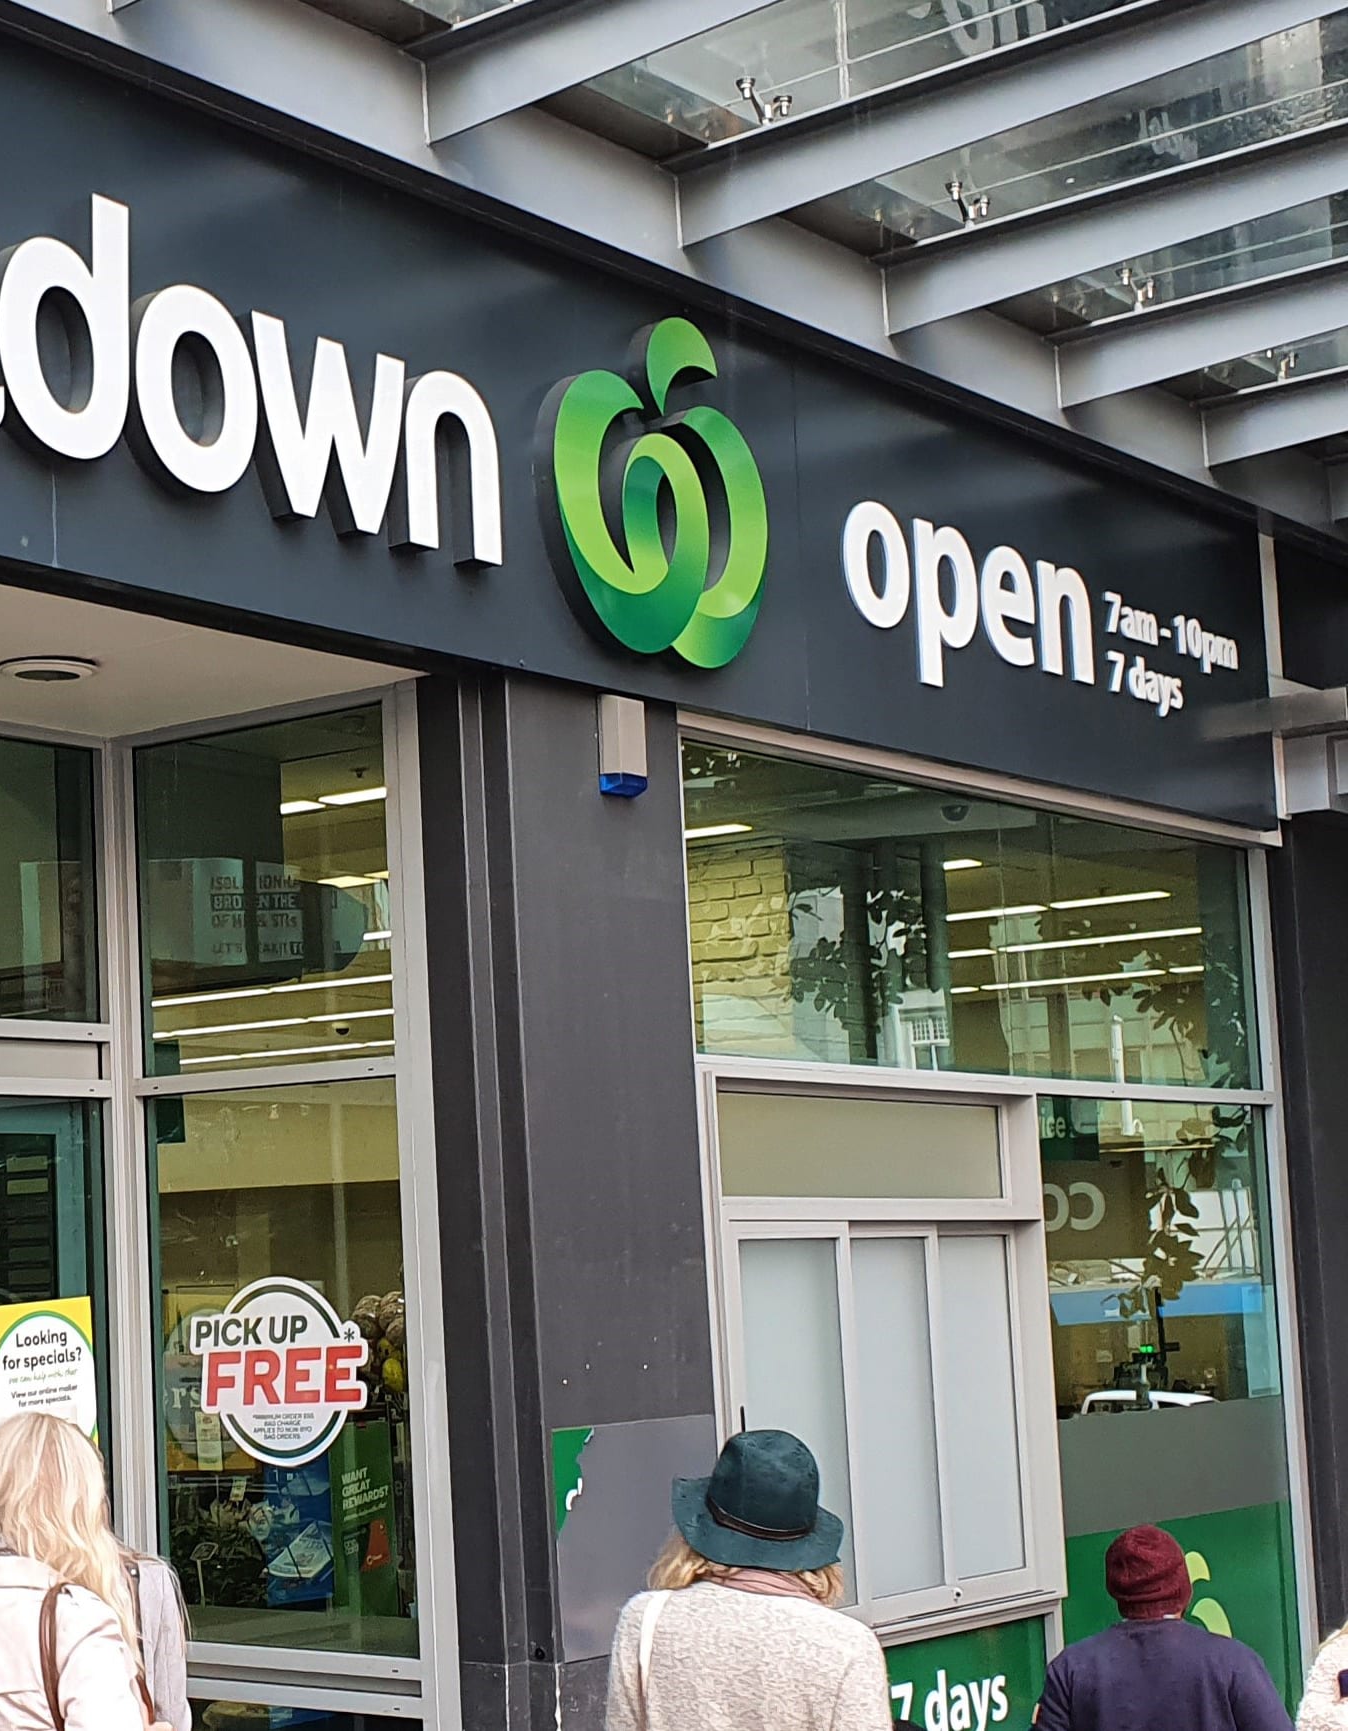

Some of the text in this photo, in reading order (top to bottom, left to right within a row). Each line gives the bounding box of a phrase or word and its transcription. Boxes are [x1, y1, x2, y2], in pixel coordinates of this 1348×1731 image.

[842, 500, 1095, 688] open
[1105, 650, 1184, 718] 7 days
[3, 1347, 82, 1371] for specials?
[16, 1329, 67, 1347] Looking
[196, 1314, 308, 1348] PICK UP
[206, 1345, 363, 1407] FREE
[924, 1669, 1009, 1731] days
